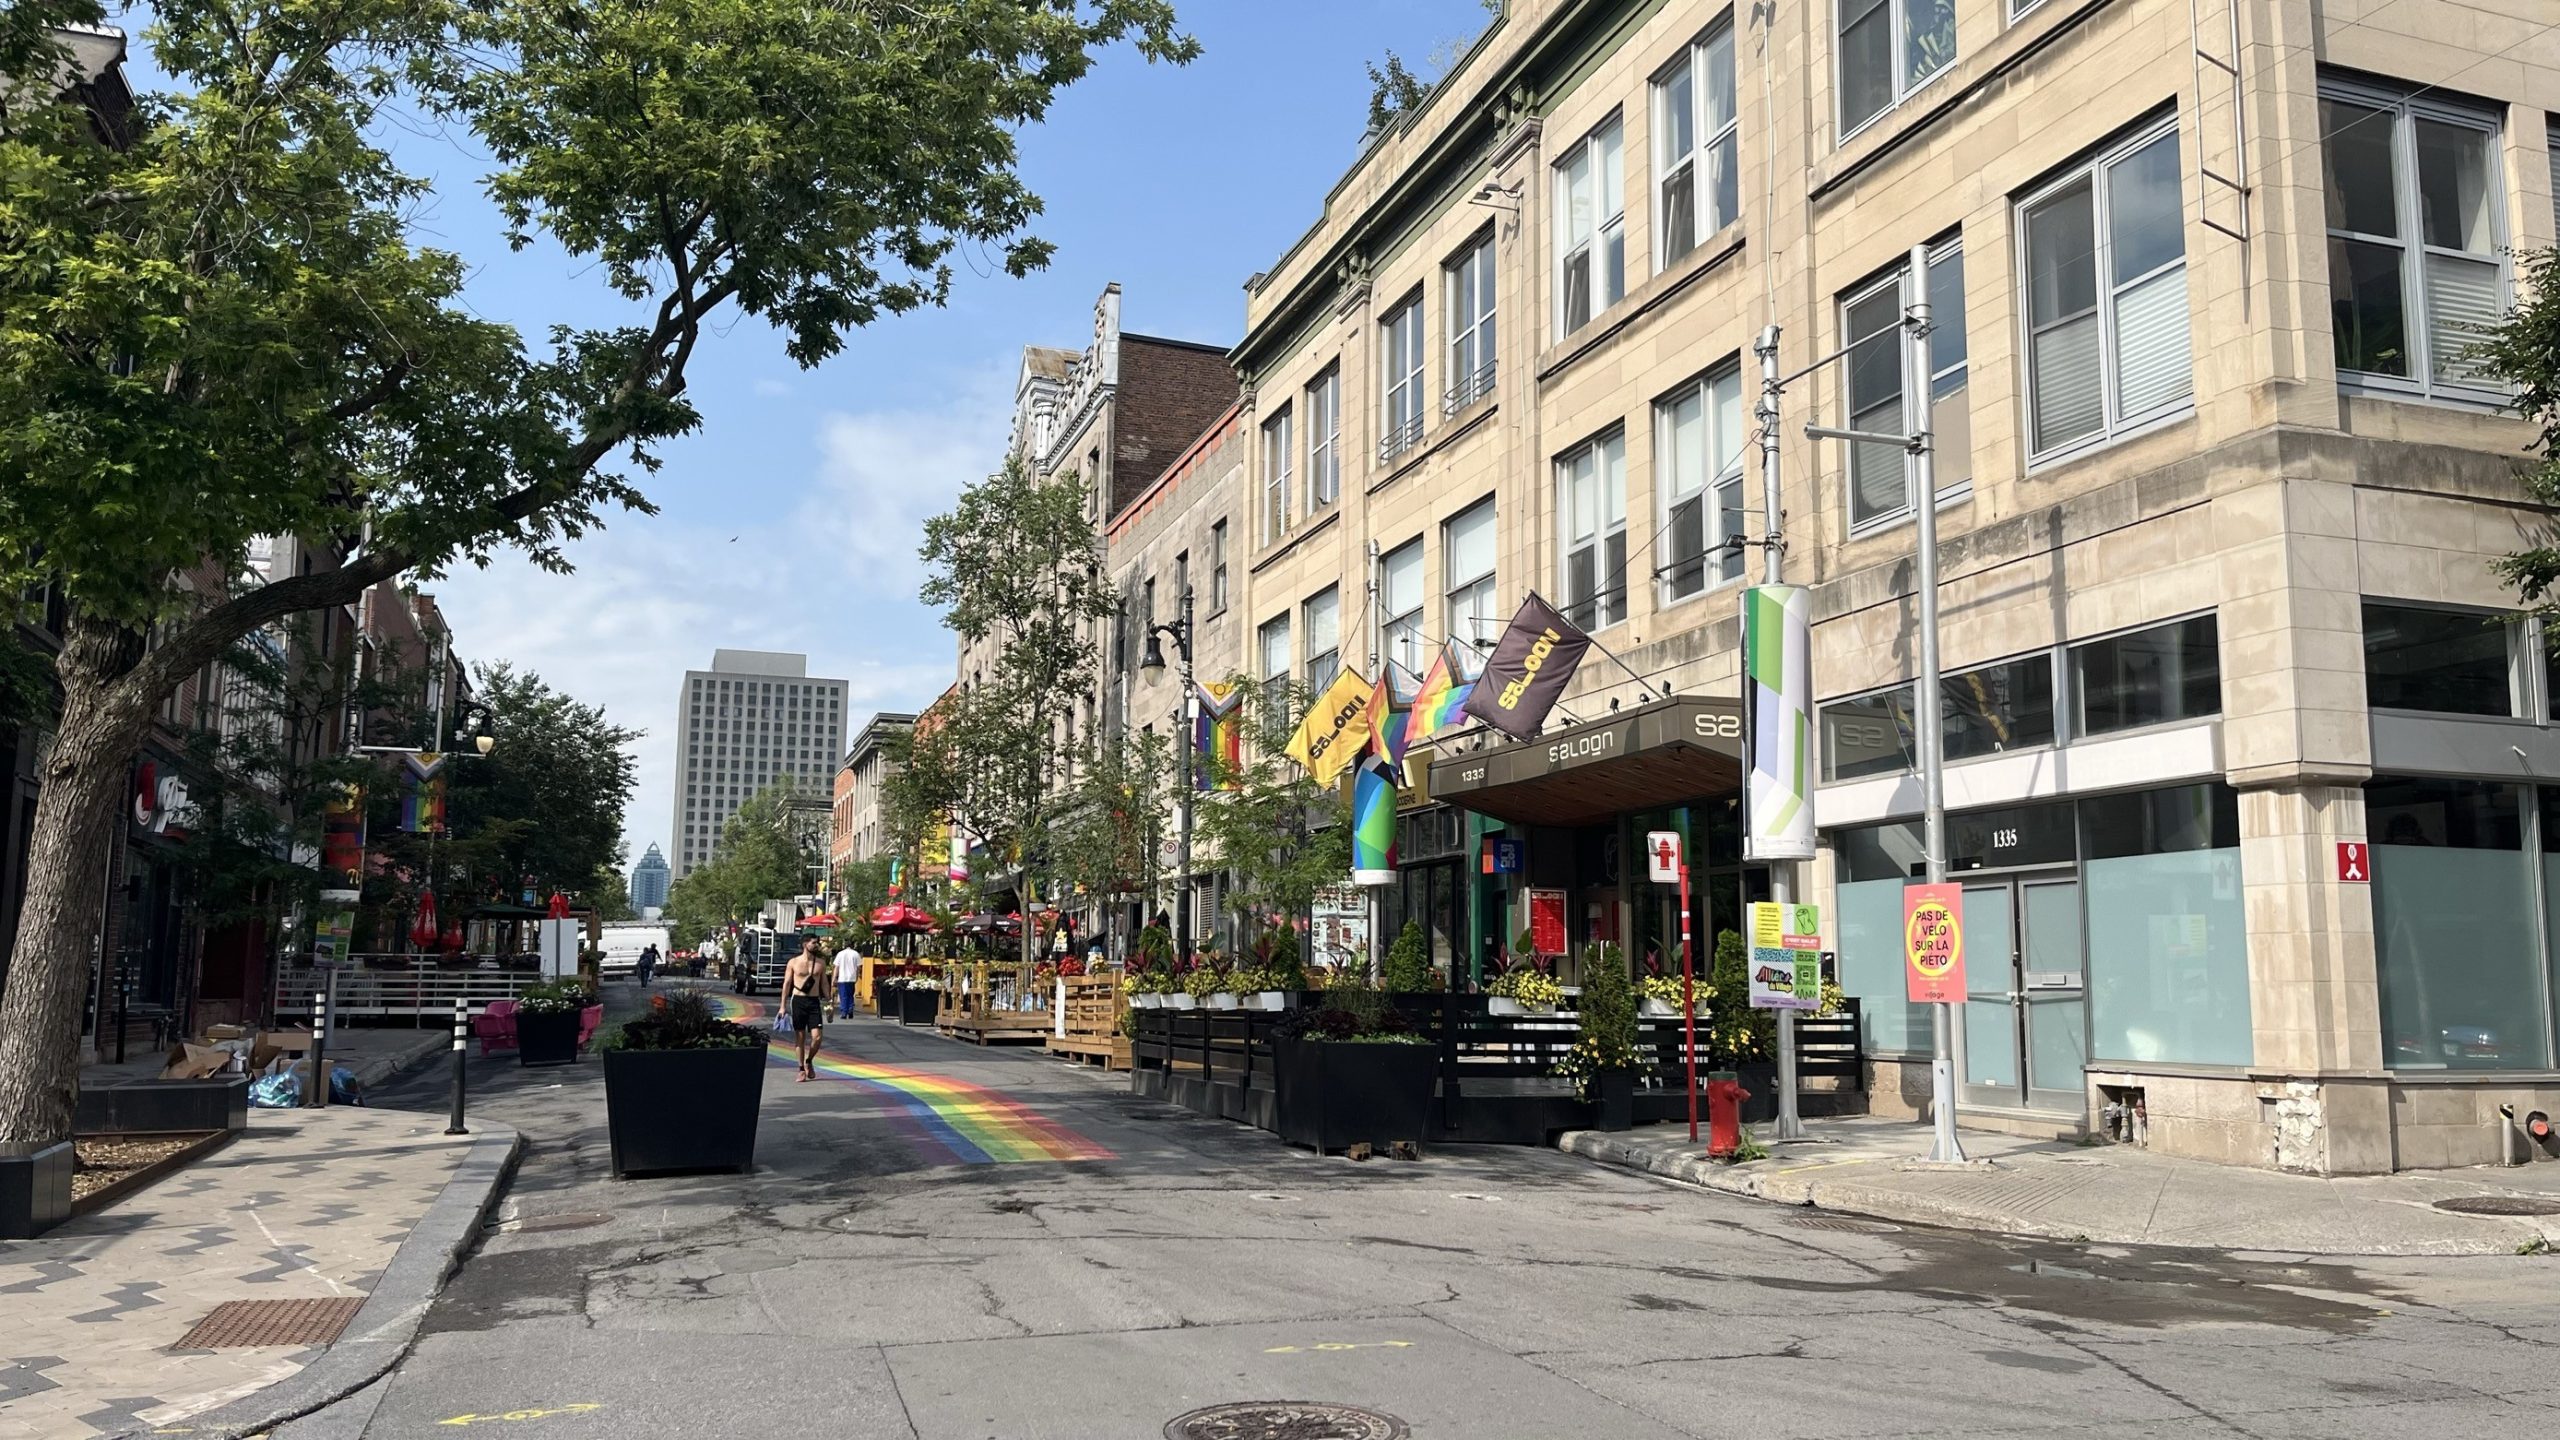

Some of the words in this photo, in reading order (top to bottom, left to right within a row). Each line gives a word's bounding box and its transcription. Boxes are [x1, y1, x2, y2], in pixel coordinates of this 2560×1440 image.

[1462, 768, 1485, 782] 1333
[1993, 829, 2018, 848] 1335
[1916, 911, 1933, 922] PAS
[1935, 910, 1949, 921] DE
[1922, 922, 1947, 936] VÉLO
[1915, 940, 1933, 951] SUR
[1936, 940, 1949, 951] LA
[1920, 952, 1948, 966] PIÉTO
